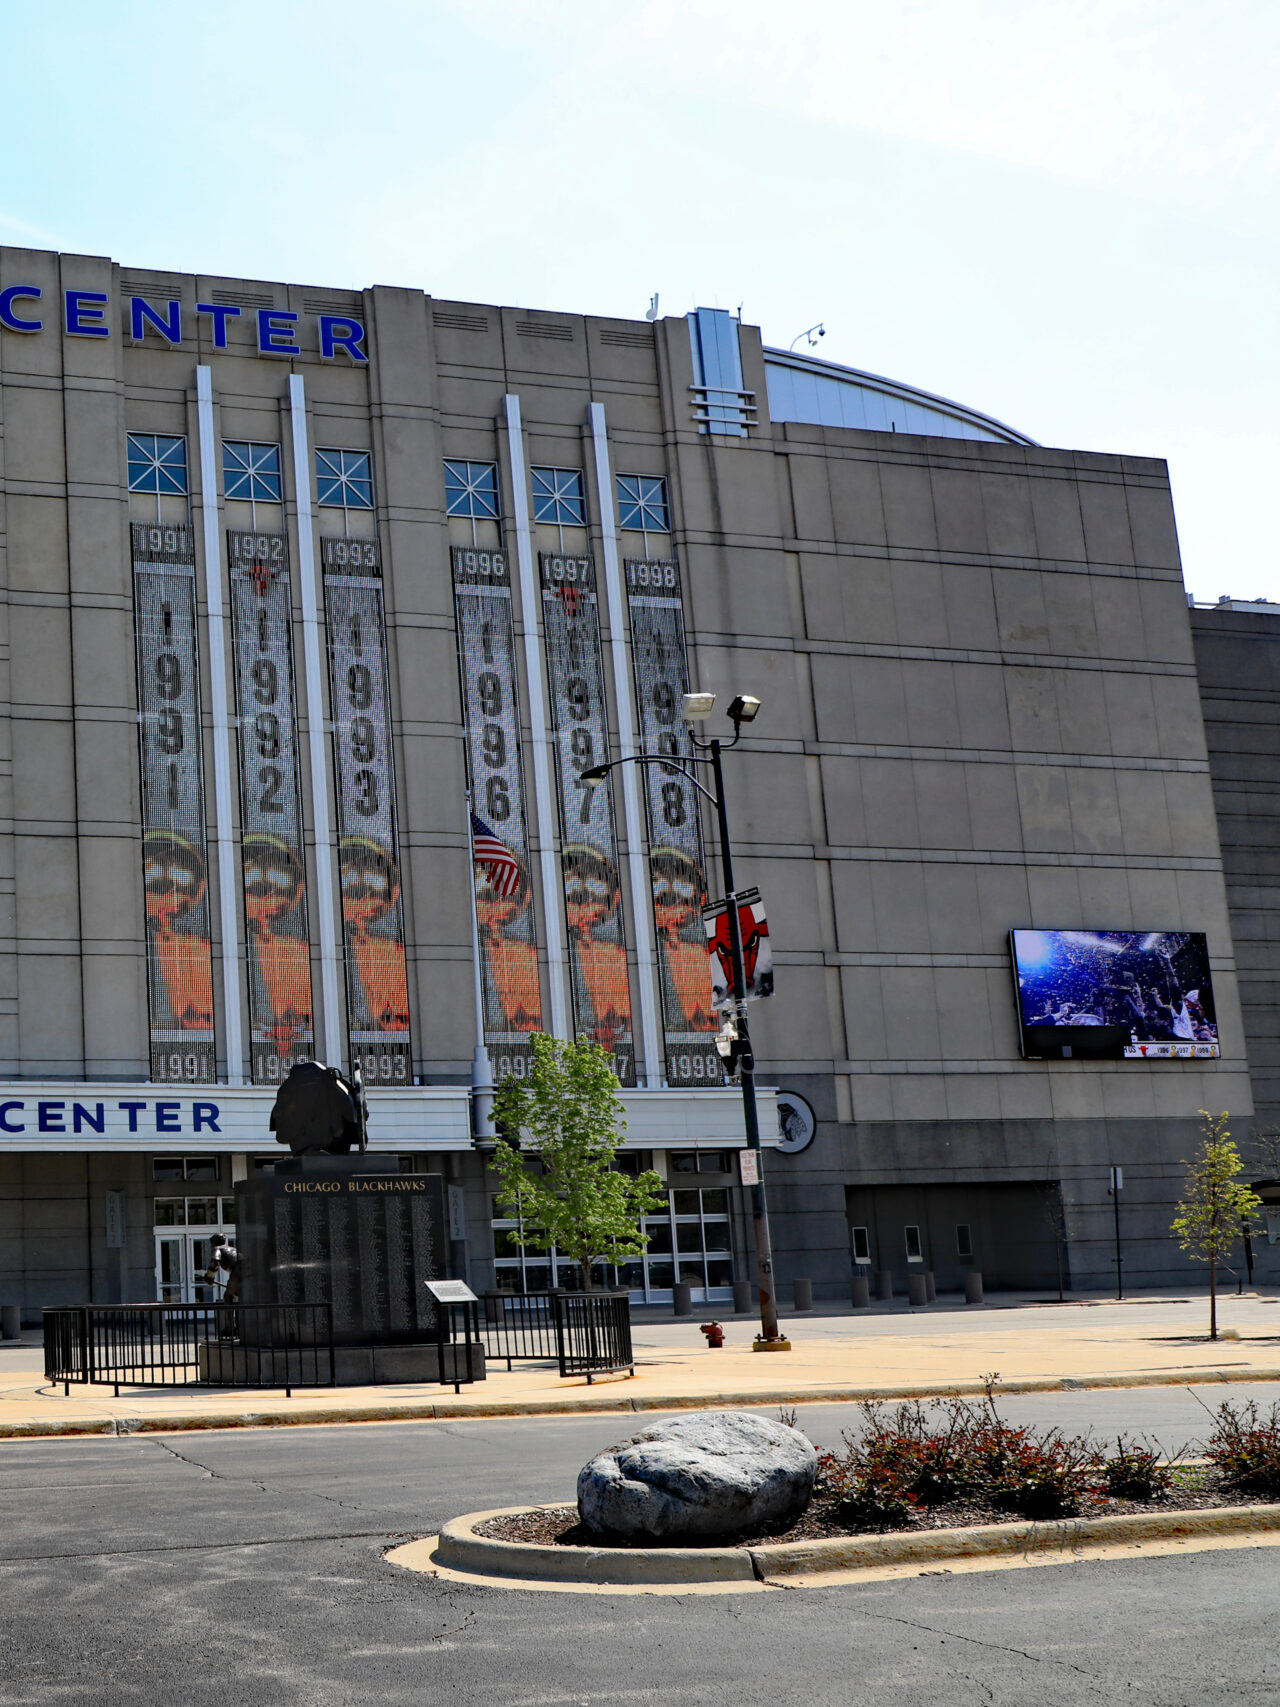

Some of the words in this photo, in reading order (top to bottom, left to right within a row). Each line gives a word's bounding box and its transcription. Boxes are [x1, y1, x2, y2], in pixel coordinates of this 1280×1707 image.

[140, 528, 187, 553] 1991
[234, 536, 284, 561] 1992
[327, 543, 376, 567] 1993
[457, 553, 504, 577] 1996
[544, 558, 590, 583] 1997
[630, 564, 676, 588] 1998
[155, 600, 183, 810] 1991
[252, 607, 284, 814] 1992
[348, 612, 378, 817] 1993
[478, 621, 510, 821] 1996
[568, 625, 595, 825] 1997
[652, 628, 686, 828] 1998
[159, 1054, 208, 1079] 1991
[356, 1055, 406, 1079] 993
[671, 1055, 717, 1079] 1998
[284, 1181, 341, 1193] CHICAGO
[348, 1180, 426, 1192] BLACKHAWKS
